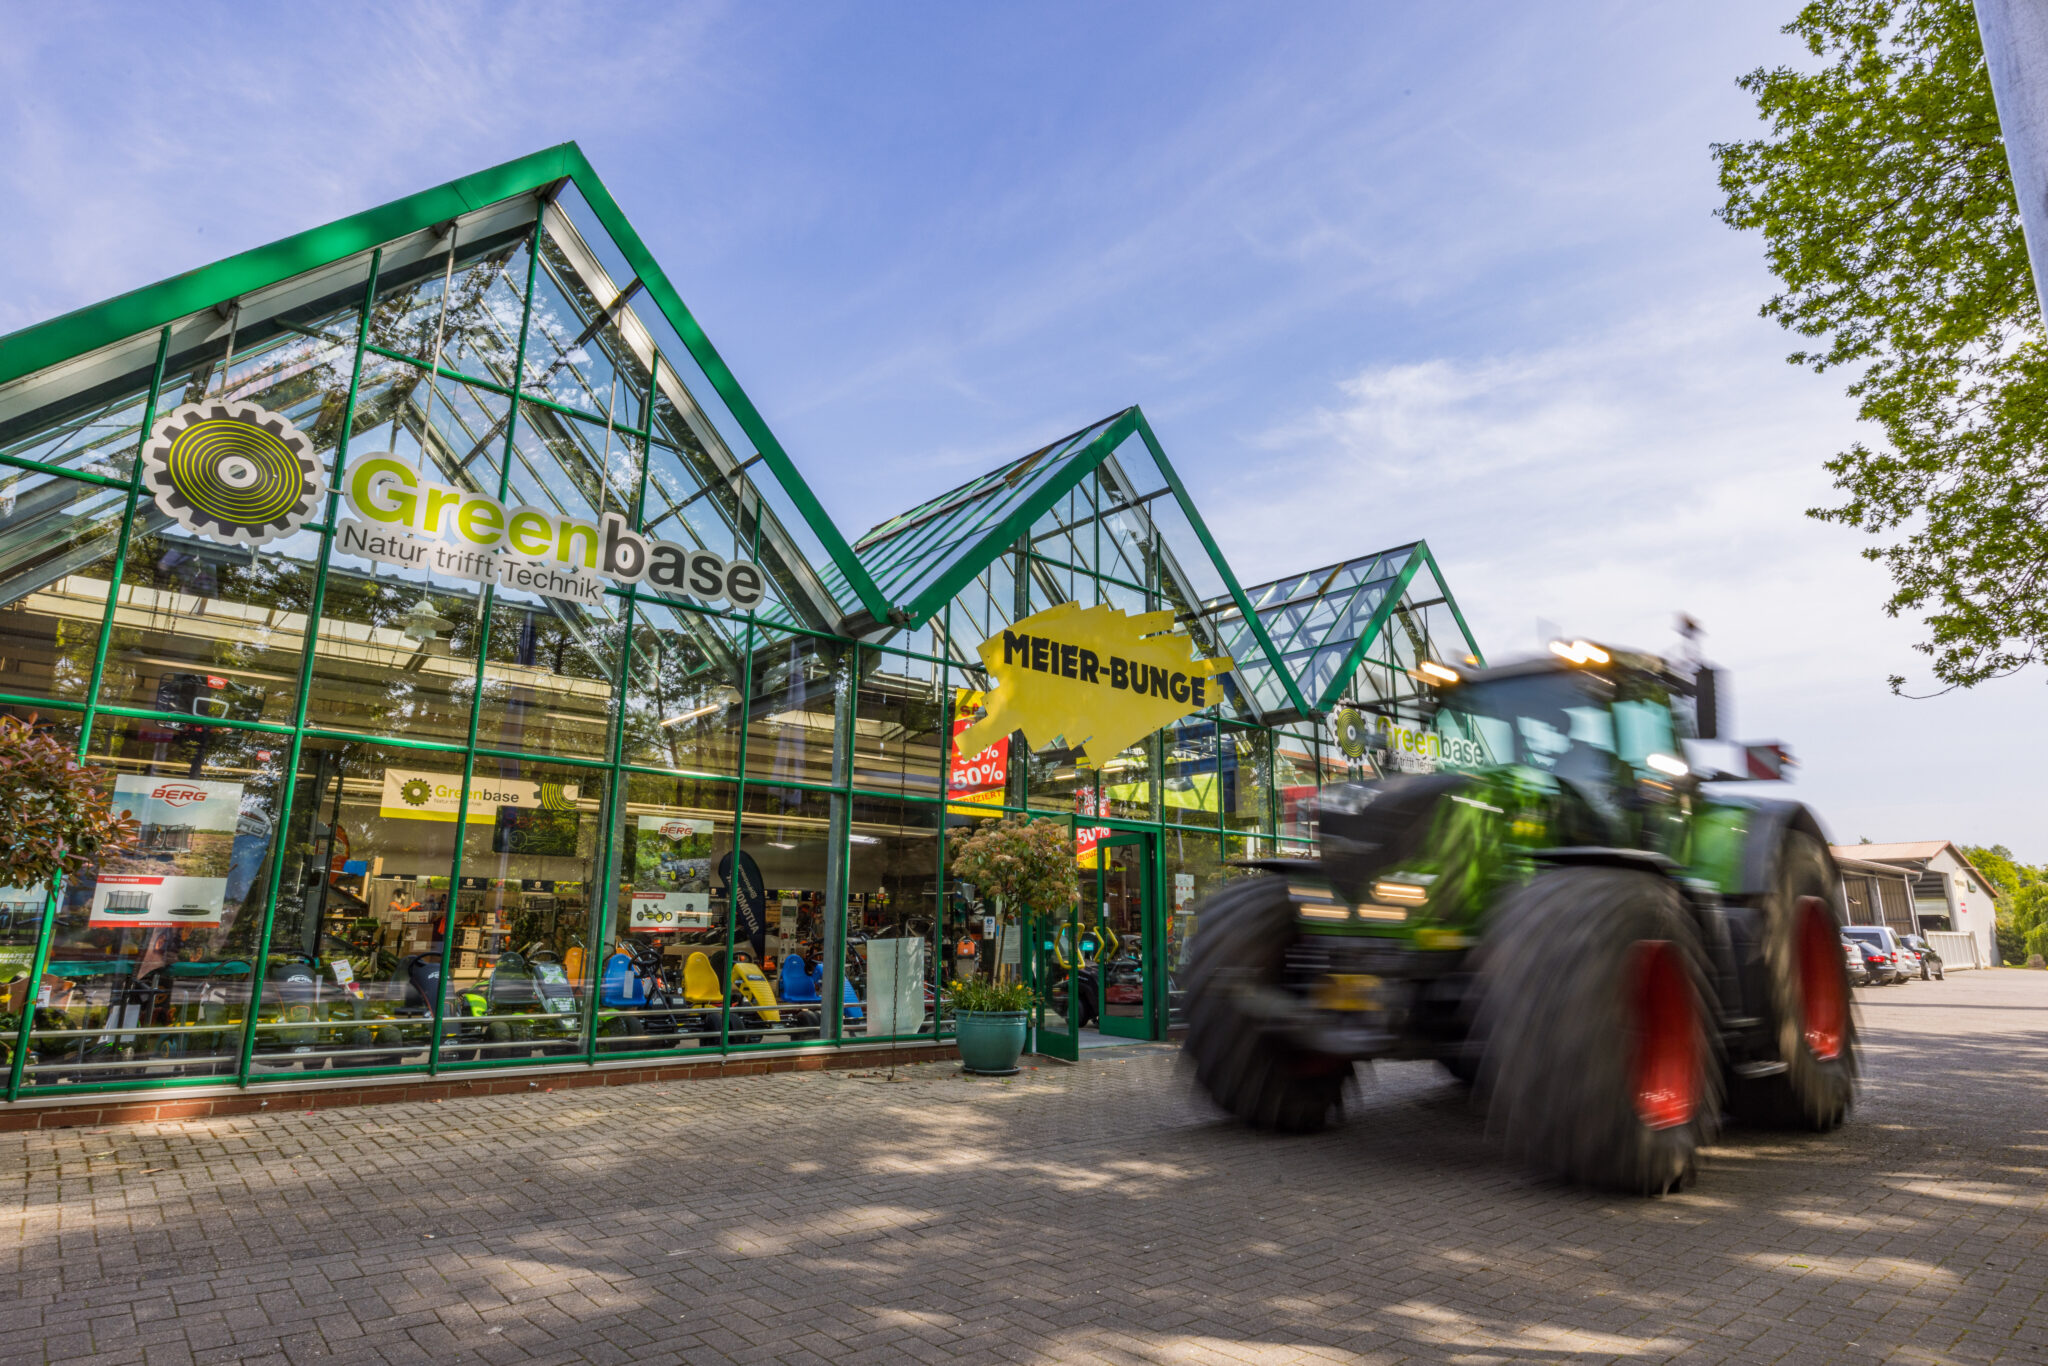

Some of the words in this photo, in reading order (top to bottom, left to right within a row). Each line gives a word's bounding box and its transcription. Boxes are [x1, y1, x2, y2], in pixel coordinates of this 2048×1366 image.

[351, 458, 763, 610] Greenbase
[343, 525, 428, 564] Natur
[436, 547, 496, 579] trifft
[502, 560, 600, 602] Technik
[1002, 629, 1206, 708] MEIER-BUNGE
[151, 788, 208, 802] BERG
[952, 762, 1004, 790] 50%
[659, 825, 693, 836] BERG
